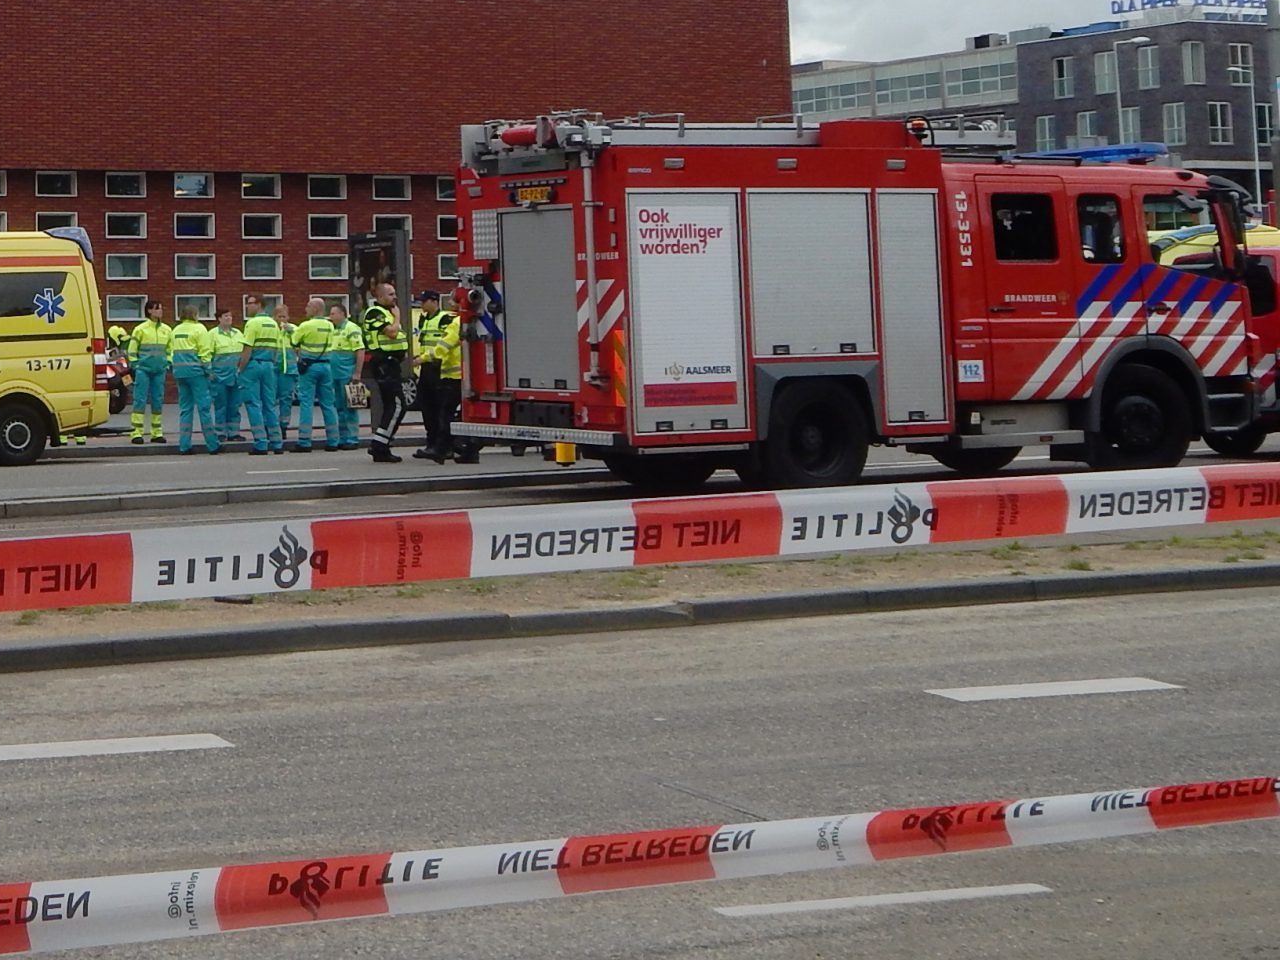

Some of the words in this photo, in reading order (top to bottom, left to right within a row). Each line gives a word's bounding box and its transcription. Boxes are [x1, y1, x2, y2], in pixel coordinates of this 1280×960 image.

[638, 208, 670, 223] Ook
[639, 223, 723, 244] vrijwilliger
[954, 190, 973, 267] 13-3531
[640, 239, 708, 254] worden?
[577, 251, 619, 261] BRDWEER
[1004, 294, 1057, 303] BRANDWEER
[26, 358, 71, 372] 13-177
[686, 365, 732, 375] AALSMEER
